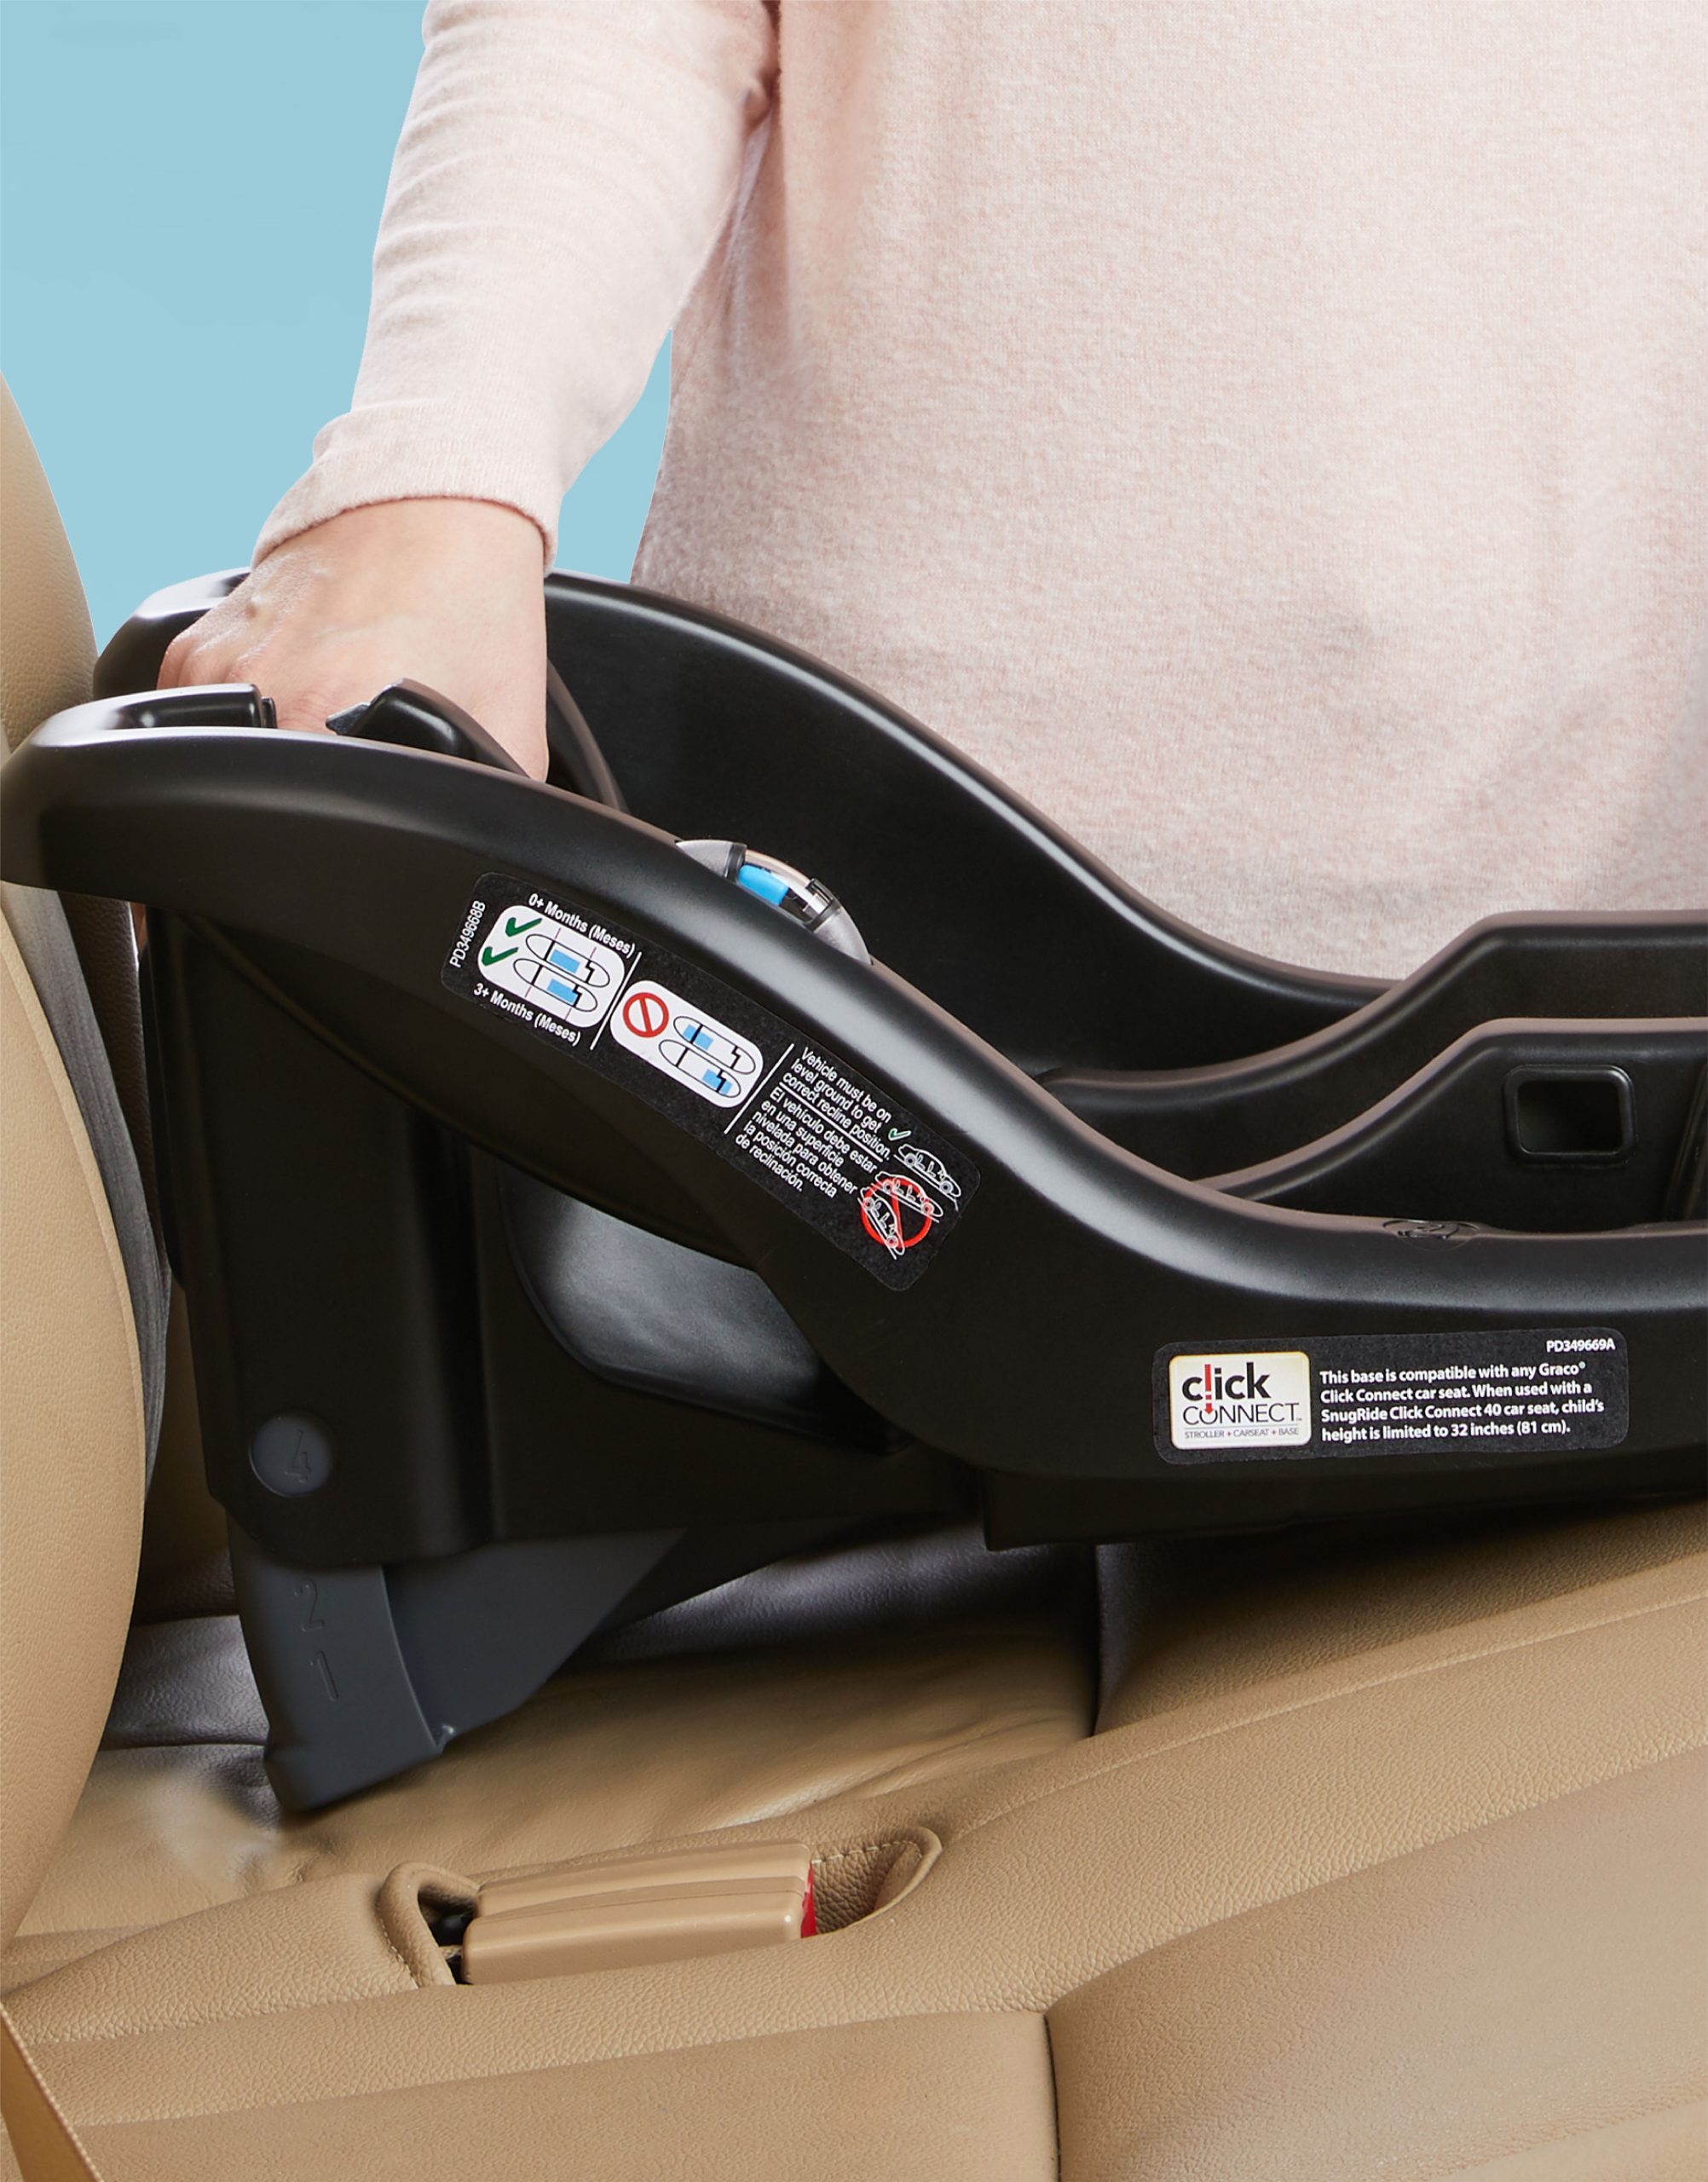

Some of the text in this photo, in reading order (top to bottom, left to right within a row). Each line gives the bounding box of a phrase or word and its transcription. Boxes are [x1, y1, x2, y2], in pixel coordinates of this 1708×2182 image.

[449, 900, 486, 968] PD349668B
[528, 892, 636, 959] 0+ Months (Meses)
[473, 982, 581, 1047] 3+ Months (Meses)
[782, 1072, 891, 1161] correct recline position.
[790, 1058, 882, 1134] level ground to get
[801, 1046, 892, 1123] Vehicle must be on
[743, 1120, 837, 1198] la posición correcta
[752, 1111, 858, 1194] nivelada para obtener
[761, 1100, 845, 1168] en una superficie
[770, 1086, 878, 1174] El vehículo debe estar
[736, 1134, 804, 1192] de reclinación.
[1320, 1370, 1349, 1385] This
[1350, 1368, 1384, 1383] base
[1385, 1367, 1397, 1382] is
[1399, 1365, 1477, 1383] compatible
[1478, 1364, 1509, 1379] with
[1510, 1364, 1537, 1380] any
[1546, 1337, 1616, 1353] PD349669A
[1320, 1379, 1593, 1404] Click Connect car seat. When used with a
[1321, 1408, 1388, 1426] SnugRide
[1389, 1406, 1424, 1420] Click
[1424, 1403, 1483, 1419] Connect
[1483, 1402, 1503, 1417] 40
[1503, 1402, 1526, 1416] car
[1526, 1401, 1561, 1417] seat,
[284, 1429, 312, 1483] 4
[1184, 1429, 1226, 1440] STROLLER
[1232, 1428, 1270, 1438] CARSEAT
[1278, 1426, 1300, 1436] BASE
[1321, 1419, 1572, 1445] height is limited to 32 inches (81 cm).
[293, 1577, 326, 1632] 2
